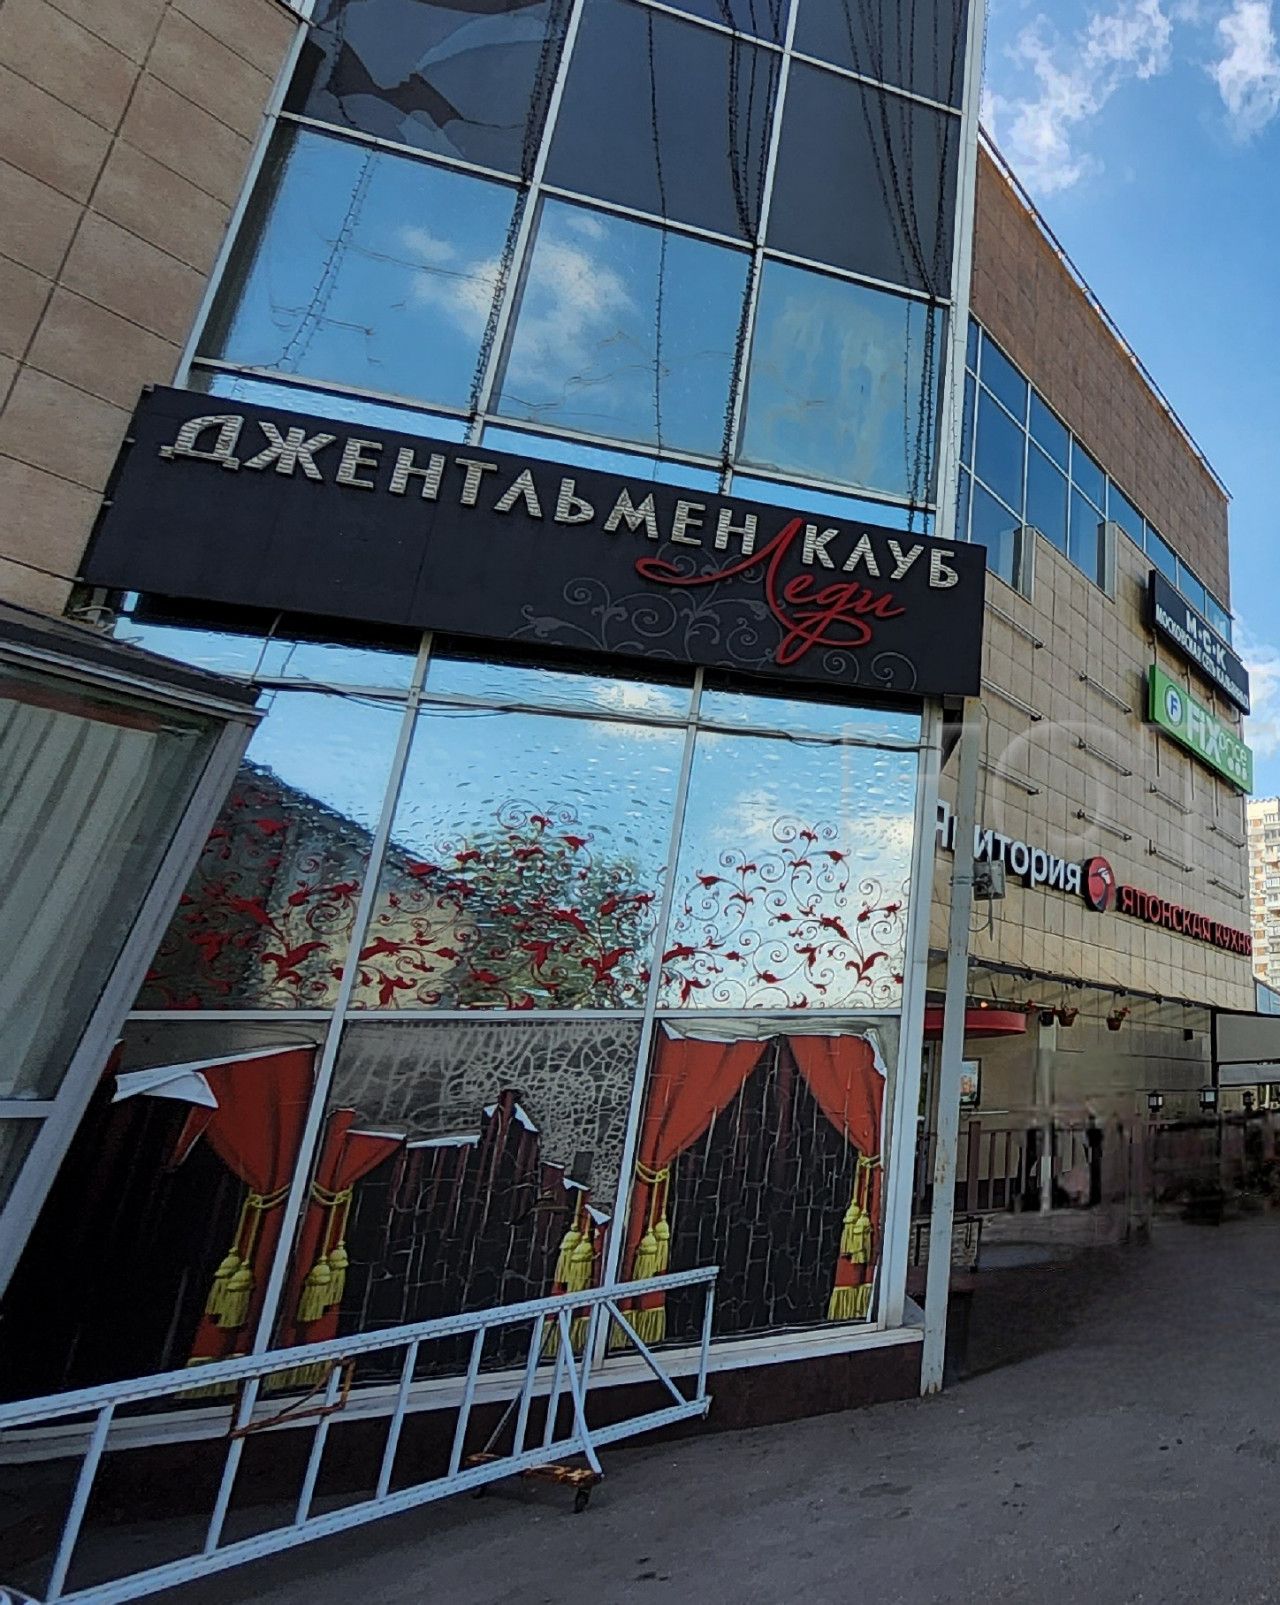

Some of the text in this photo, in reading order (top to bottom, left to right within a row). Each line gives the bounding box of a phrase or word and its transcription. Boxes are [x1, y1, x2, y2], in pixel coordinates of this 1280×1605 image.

[159, 412, 961, 590] ДЖЕНТЛЬМЕН КЛУБ
[635, 518, 907, 667] Леди
[936, 799, 1082, 894] Яитория
[1122, 885, 1253, 956] ЯПОНСКАЯ КУХНЯ
